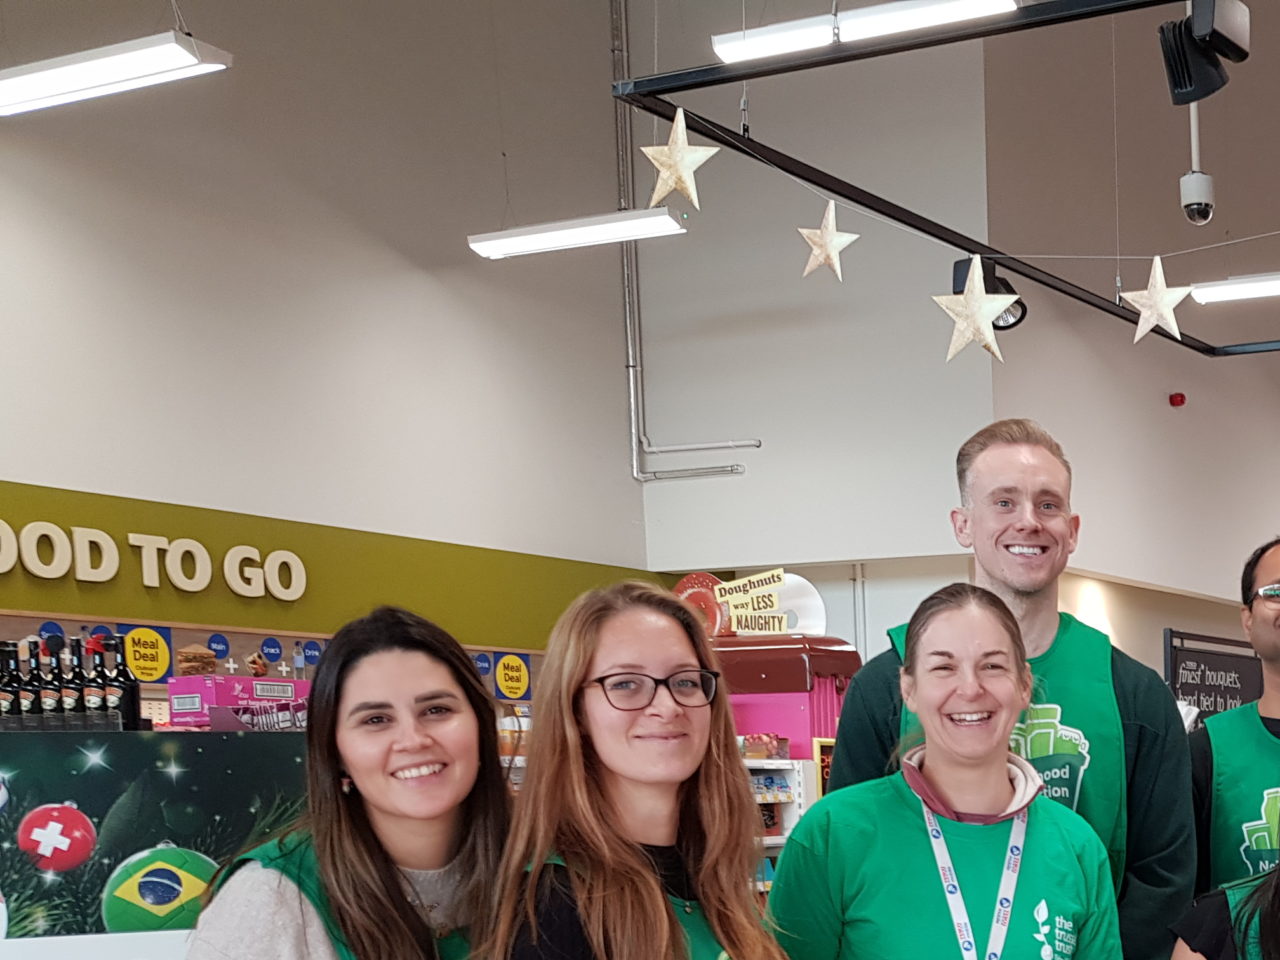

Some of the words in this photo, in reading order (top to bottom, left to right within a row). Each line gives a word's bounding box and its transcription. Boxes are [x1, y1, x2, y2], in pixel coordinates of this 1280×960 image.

[127, 532, 213, 593] TO
[223, 545, 307, 602] GO
[718, 572, 783, 599] Doughnuts
[733, 601, 751, 611] way
[751, 594, 774, 612] LESS
[736, 614, 784, 632] NAUGHTY
[131, 637, 159, 650] Meal
[263, 646, 280, 654] Snack
[133, 650, 159, 663] Deal
[503, 662, 522, 673] Meal
[504, 672, 522, 683] Deal
[1205, 666, 1241, 690] bouquets,
[1200, 692, 1214, 711] tied
[1216, 695, 1225, 712] to
[1055, 916, 1073, 931] the
